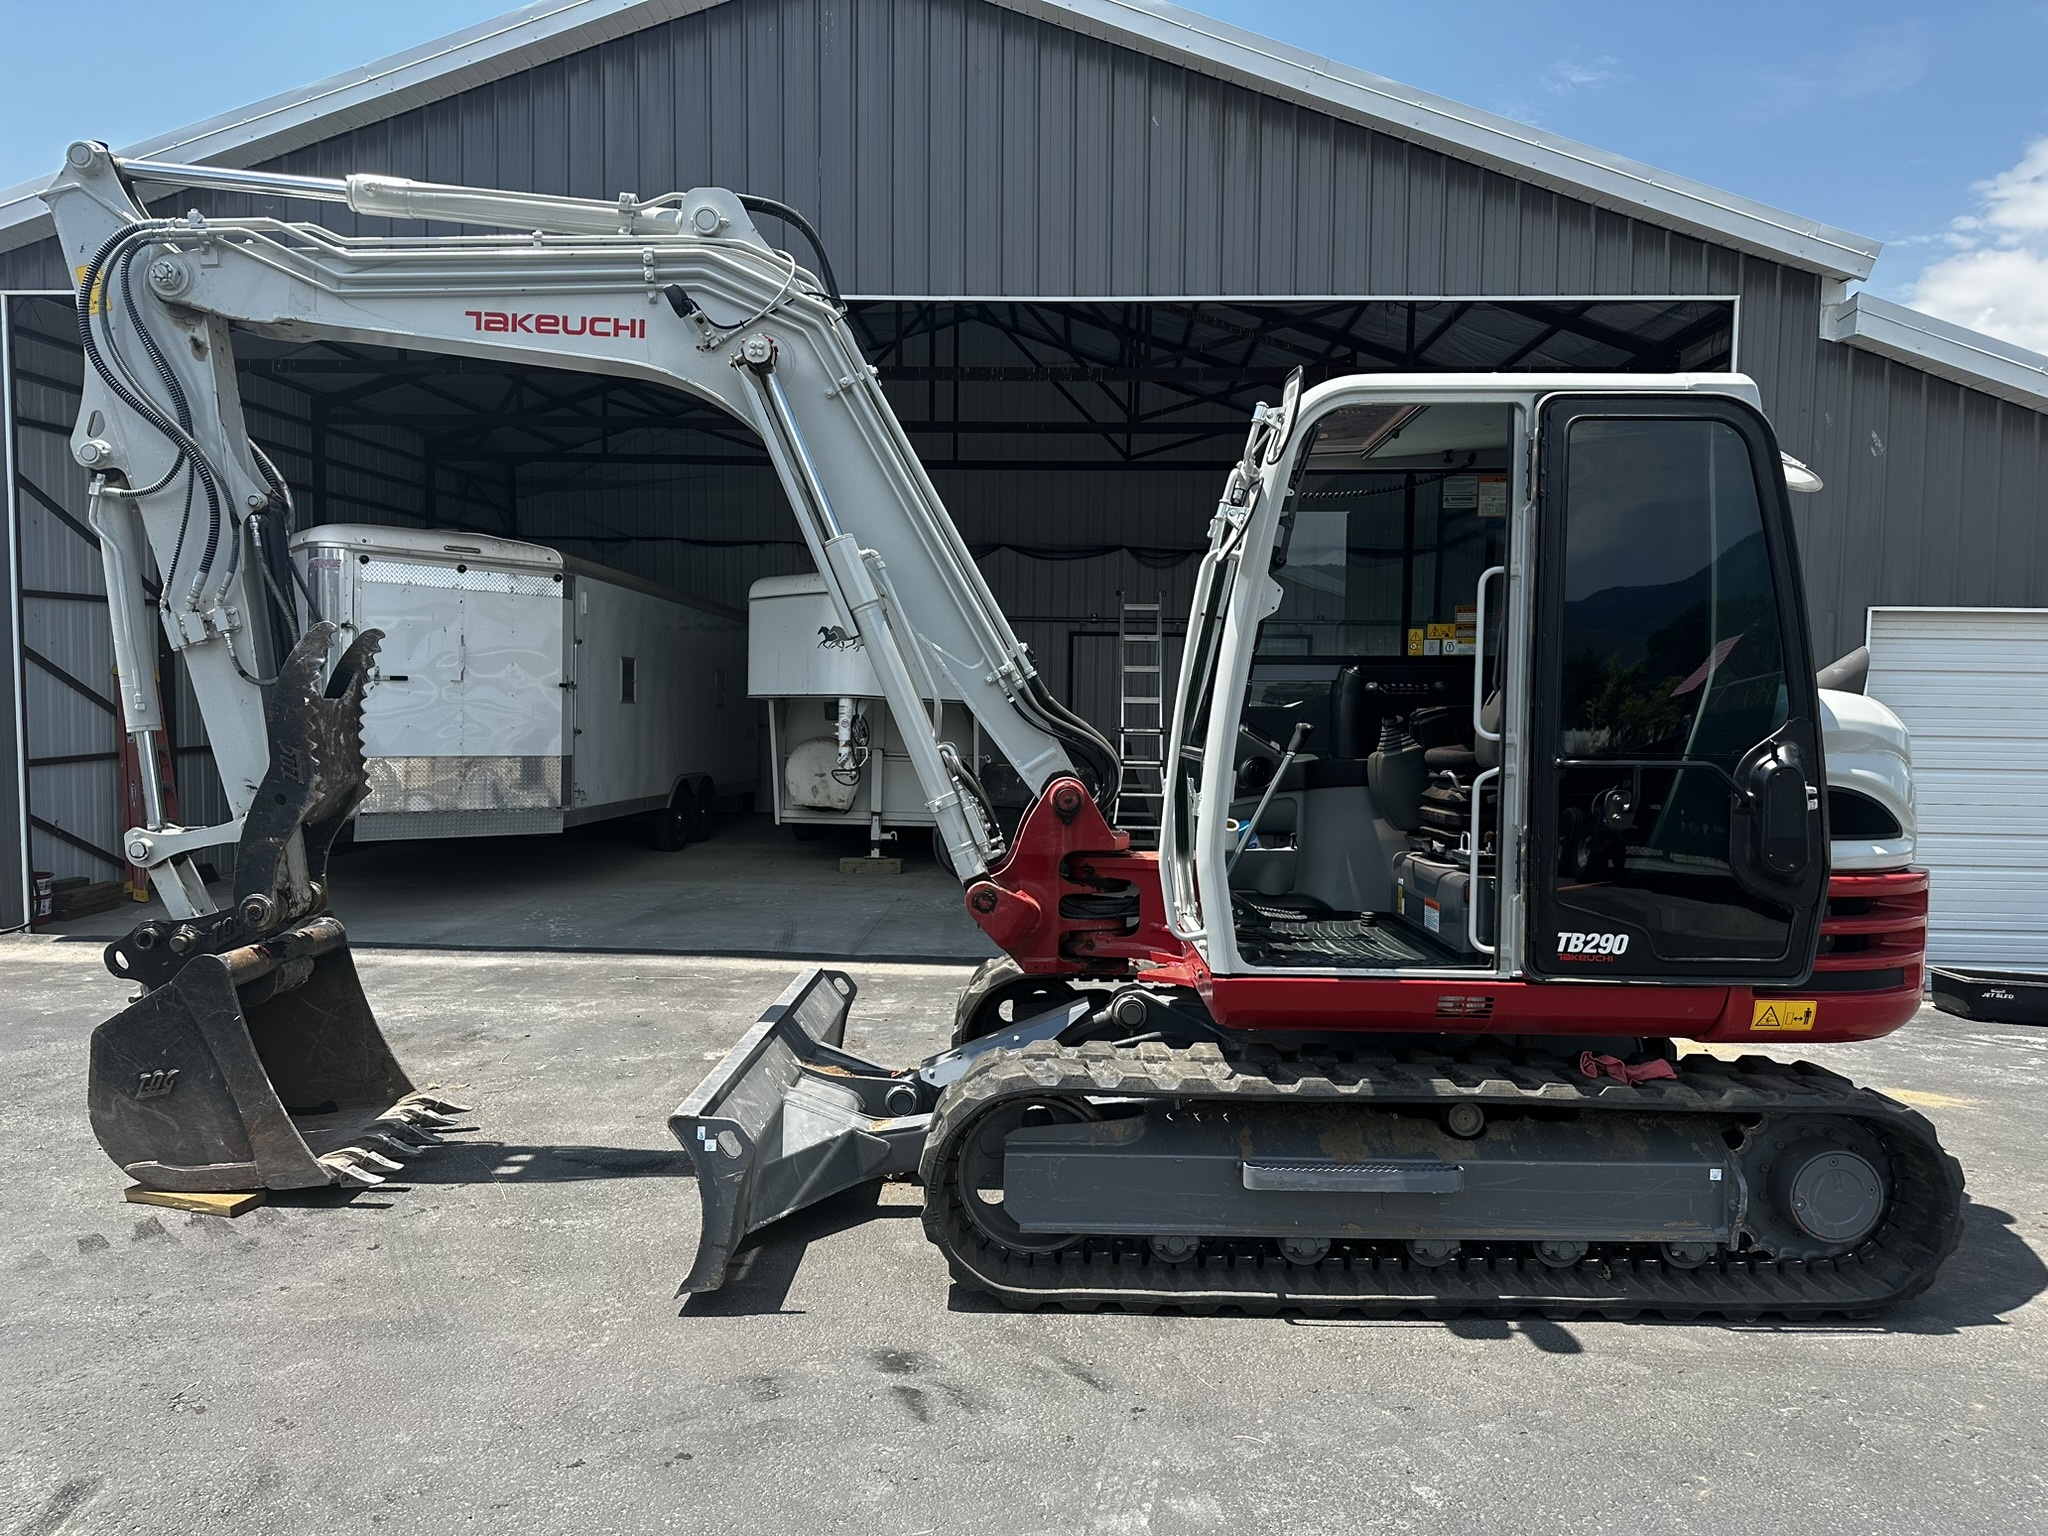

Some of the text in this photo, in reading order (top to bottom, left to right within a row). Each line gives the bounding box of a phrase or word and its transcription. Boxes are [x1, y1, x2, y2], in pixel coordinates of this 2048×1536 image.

[465, 310, 646, 339] TAKEUCHI
[1557, 931, 1629, 955] TB290
[1557, 953, 1614, 963] TAKEUCHI
